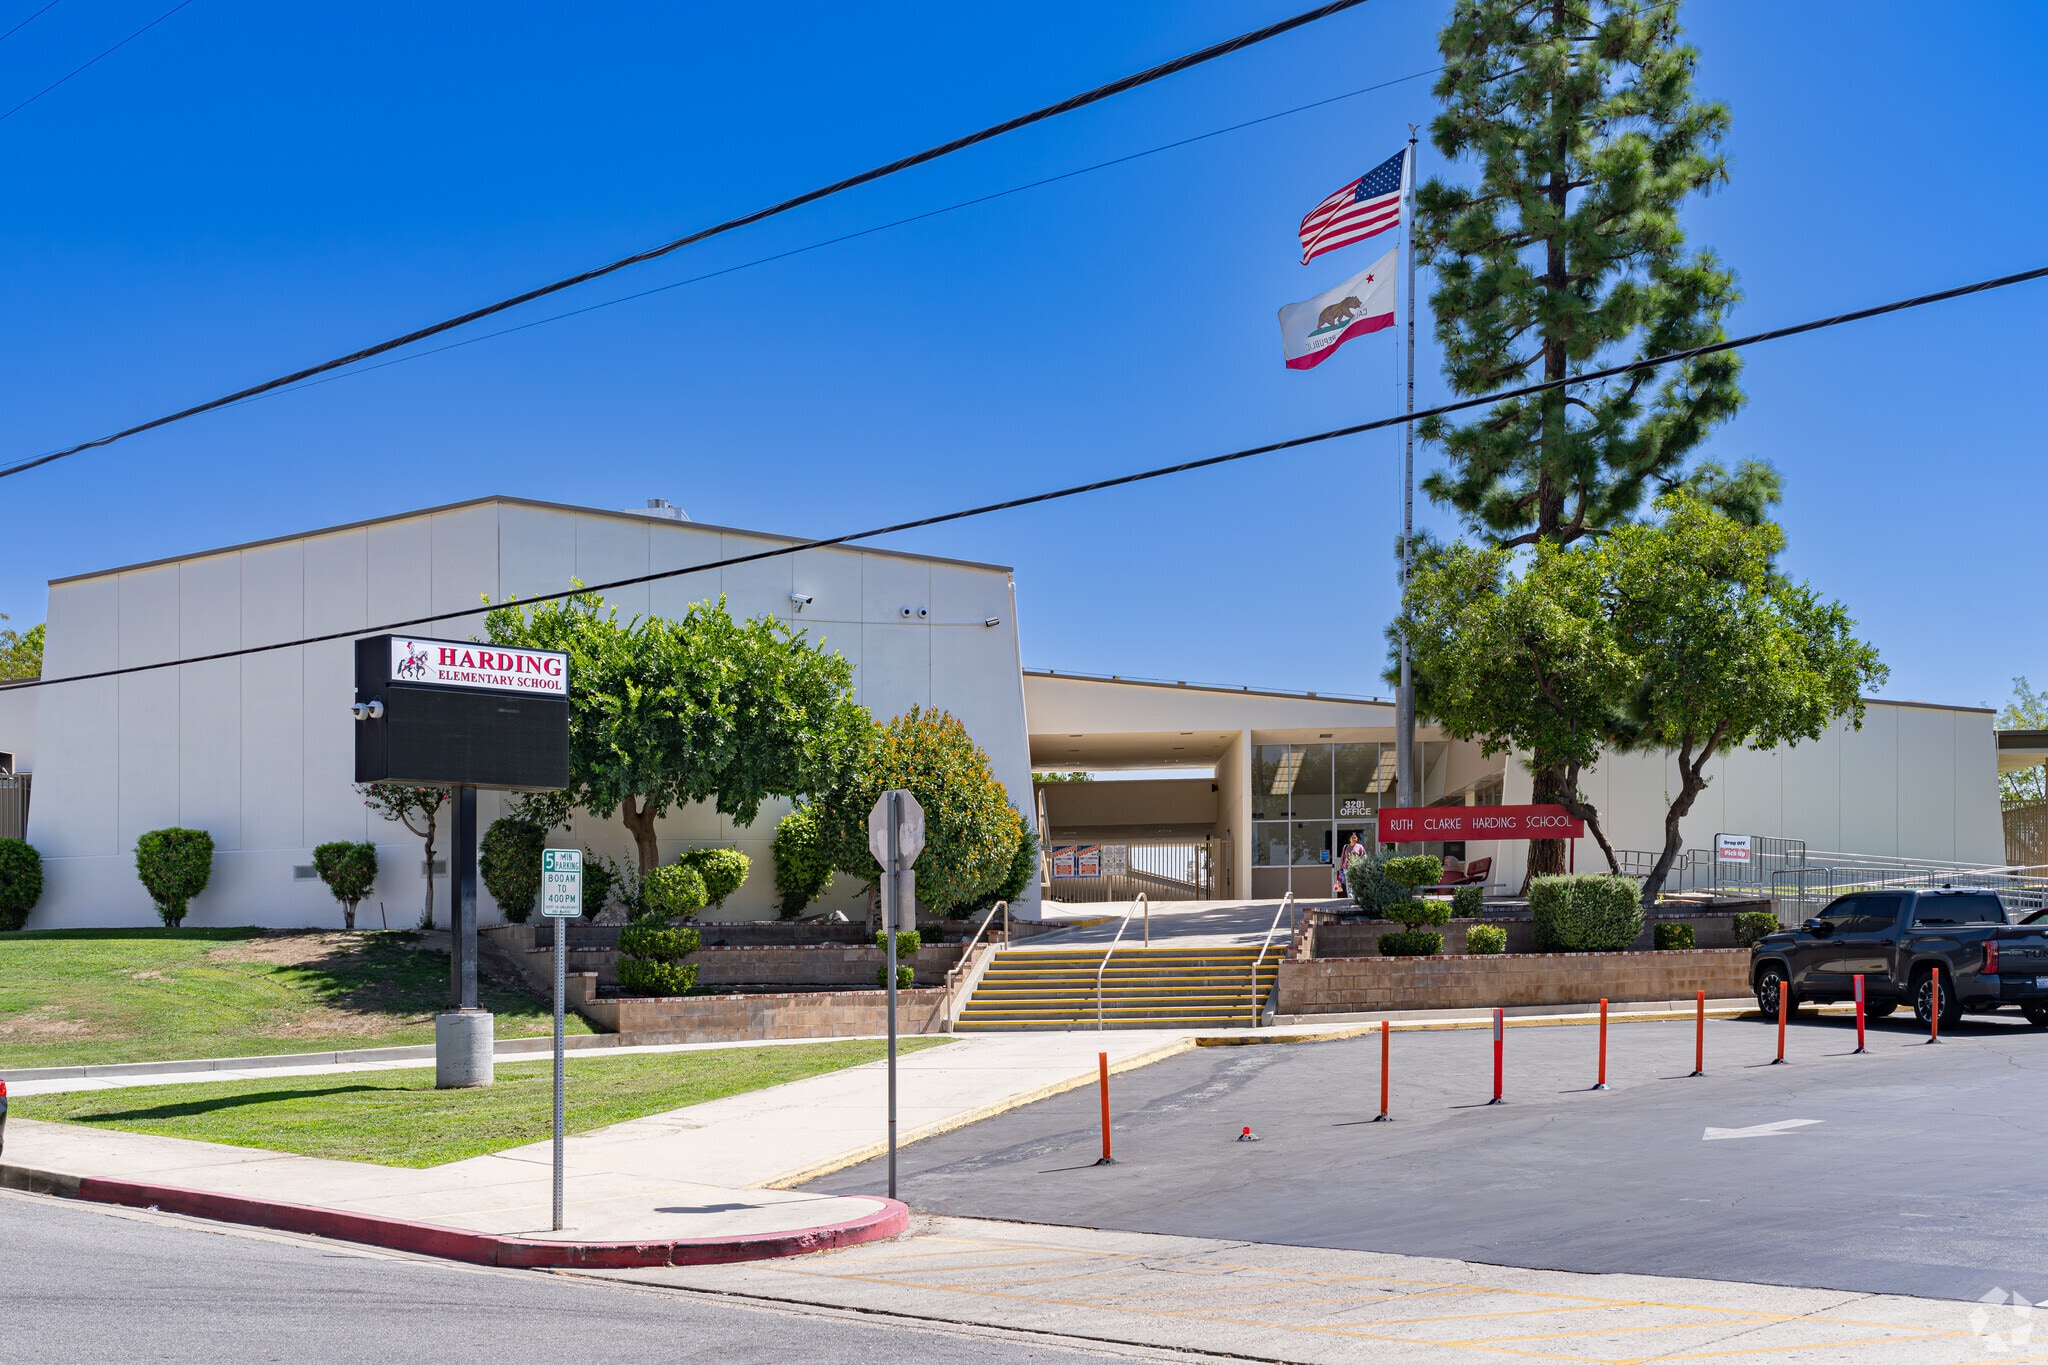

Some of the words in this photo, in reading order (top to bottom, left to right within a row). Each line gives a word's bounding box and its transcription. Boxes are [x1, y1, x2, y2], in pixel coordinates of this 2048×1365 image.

[438, 646, 562, 677] HARDING
[438, 669, 515, 686] ELEMENTARY
[517, 676, 562, 690] SCHOOL
[1345, 800, 1365, 808] 3201
[1340, 807, 1371, 816] OFFICE
[1390, 819, 1413, 830] RUTH
[1424, 818, 1461, 830] CLARKE
[1472, 816, 1517, 829] HARDING
[1525, 815, 1573, 829] SCHOOL
[560, 852, 573, 862] MIN
[1737, 850, 1746, 858] Up
[546, 852, 554, 870] 5
[555, 861, 579, 871] PARKING
[557, 884, 567, 893] TO
